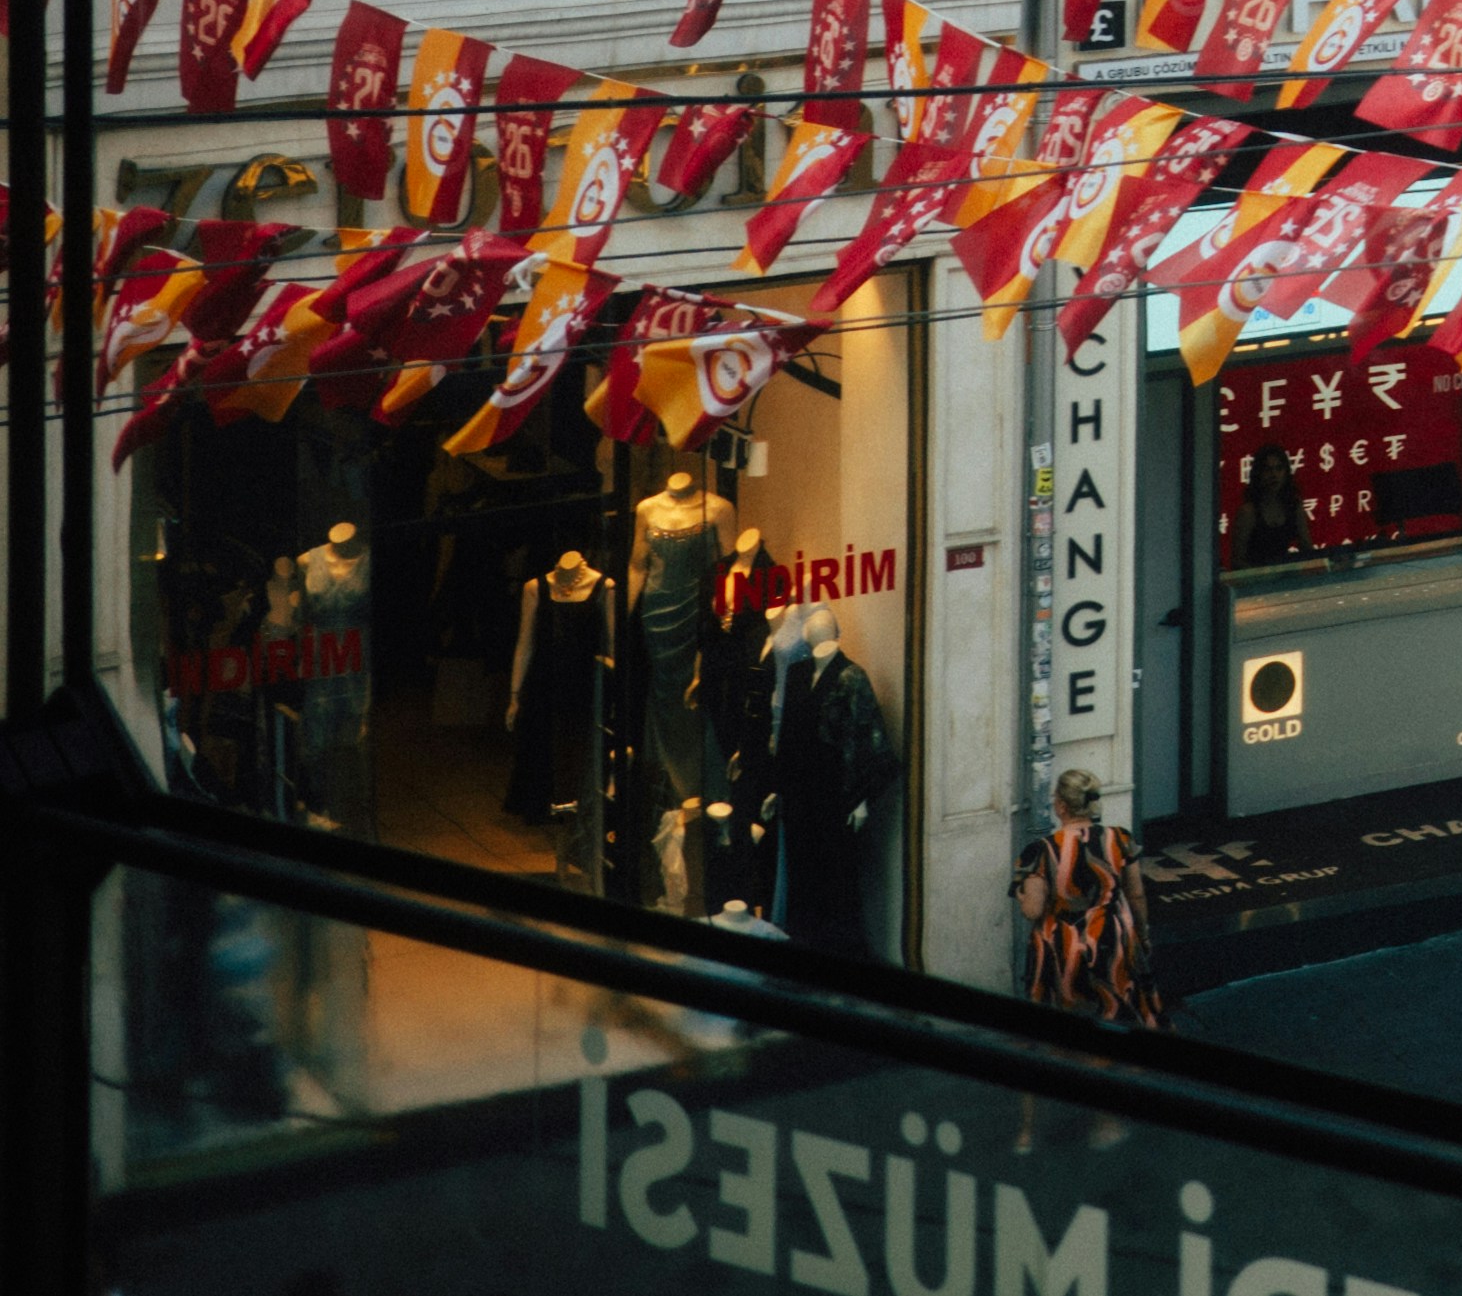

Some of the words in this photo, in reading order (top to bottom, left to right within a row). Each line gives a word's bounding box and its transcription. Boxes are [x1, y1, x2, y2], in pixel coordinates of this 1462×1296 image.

[1357, 41, 1399, 57] ETKİLİ
[1433, 374, 1450, 392] NO
[716, 542, 898, 618] İNDİRİM
[1243, 719, 1302, 745] GOLD
[1254, 864, 1341, 888] GRUP
